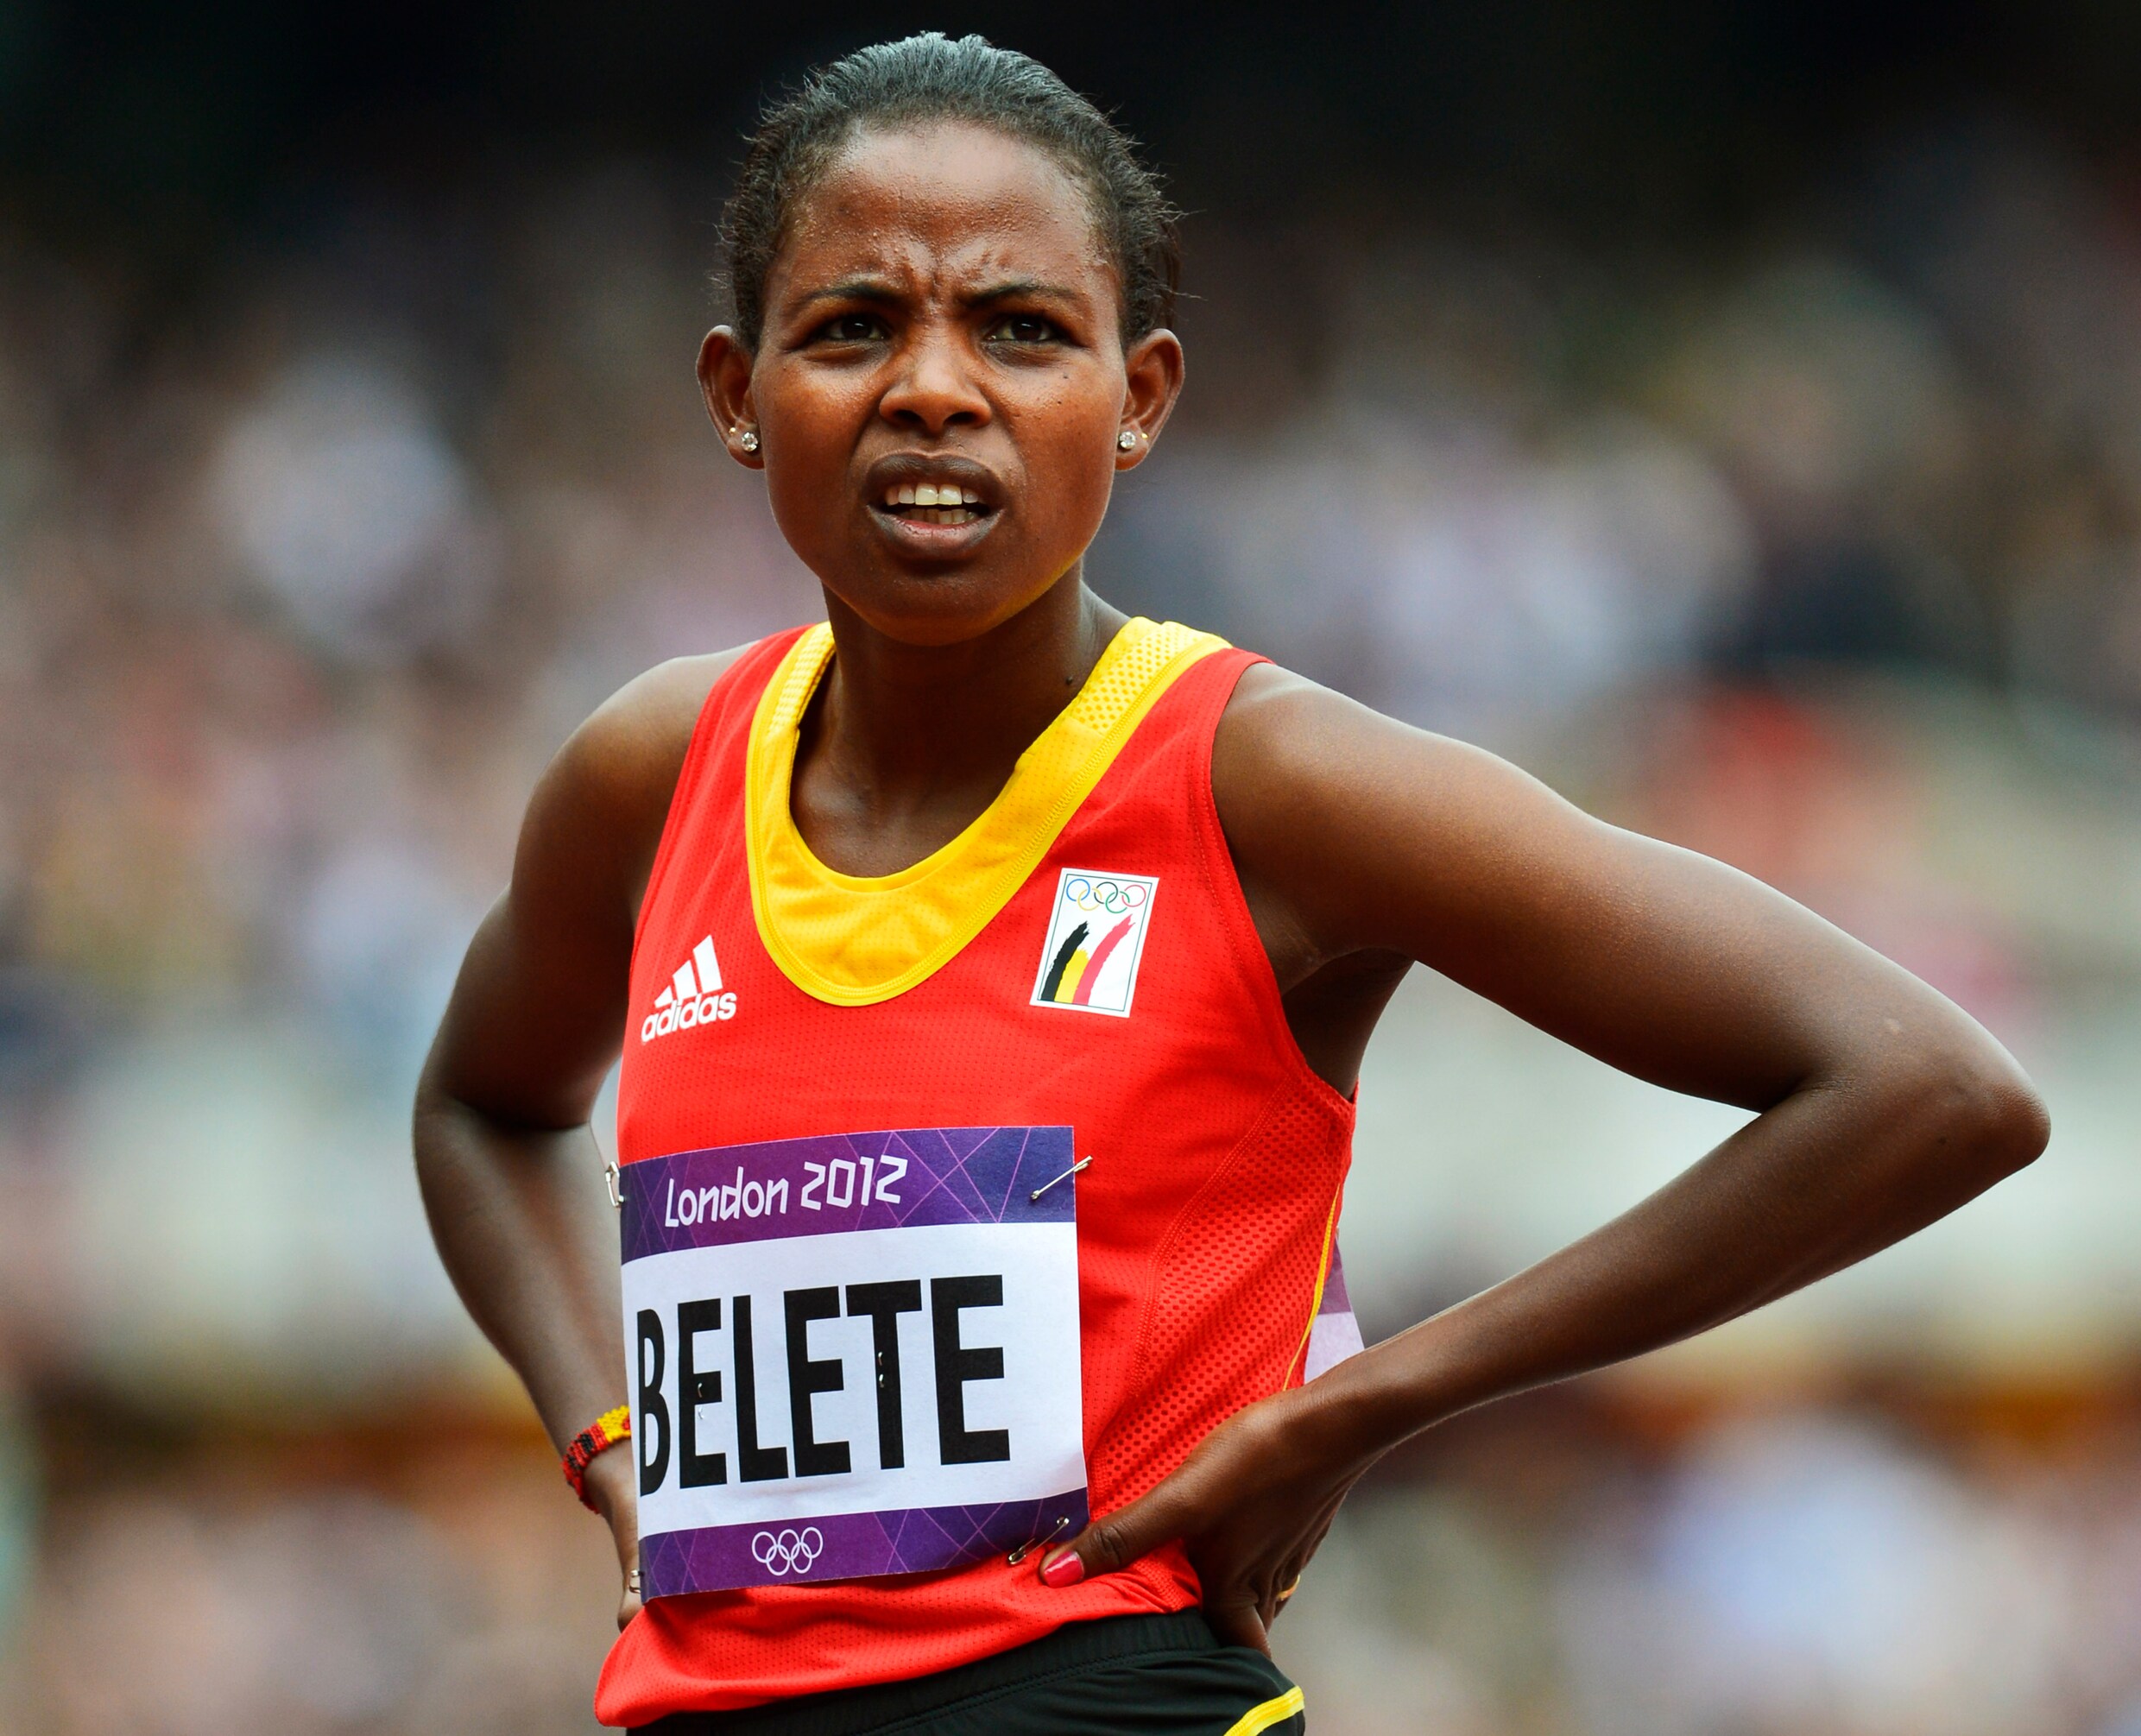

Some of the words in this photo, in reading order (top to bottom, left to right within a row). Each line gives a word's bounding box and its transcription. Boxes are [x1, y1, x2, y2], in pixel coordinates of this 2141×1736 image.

[641, 992, 737, 1044] adidas
[664, 1165, 789, 1228] London
[800, 1154, 908, 1210] 2012
[636, 1274, 1011, 1498] BELETE
